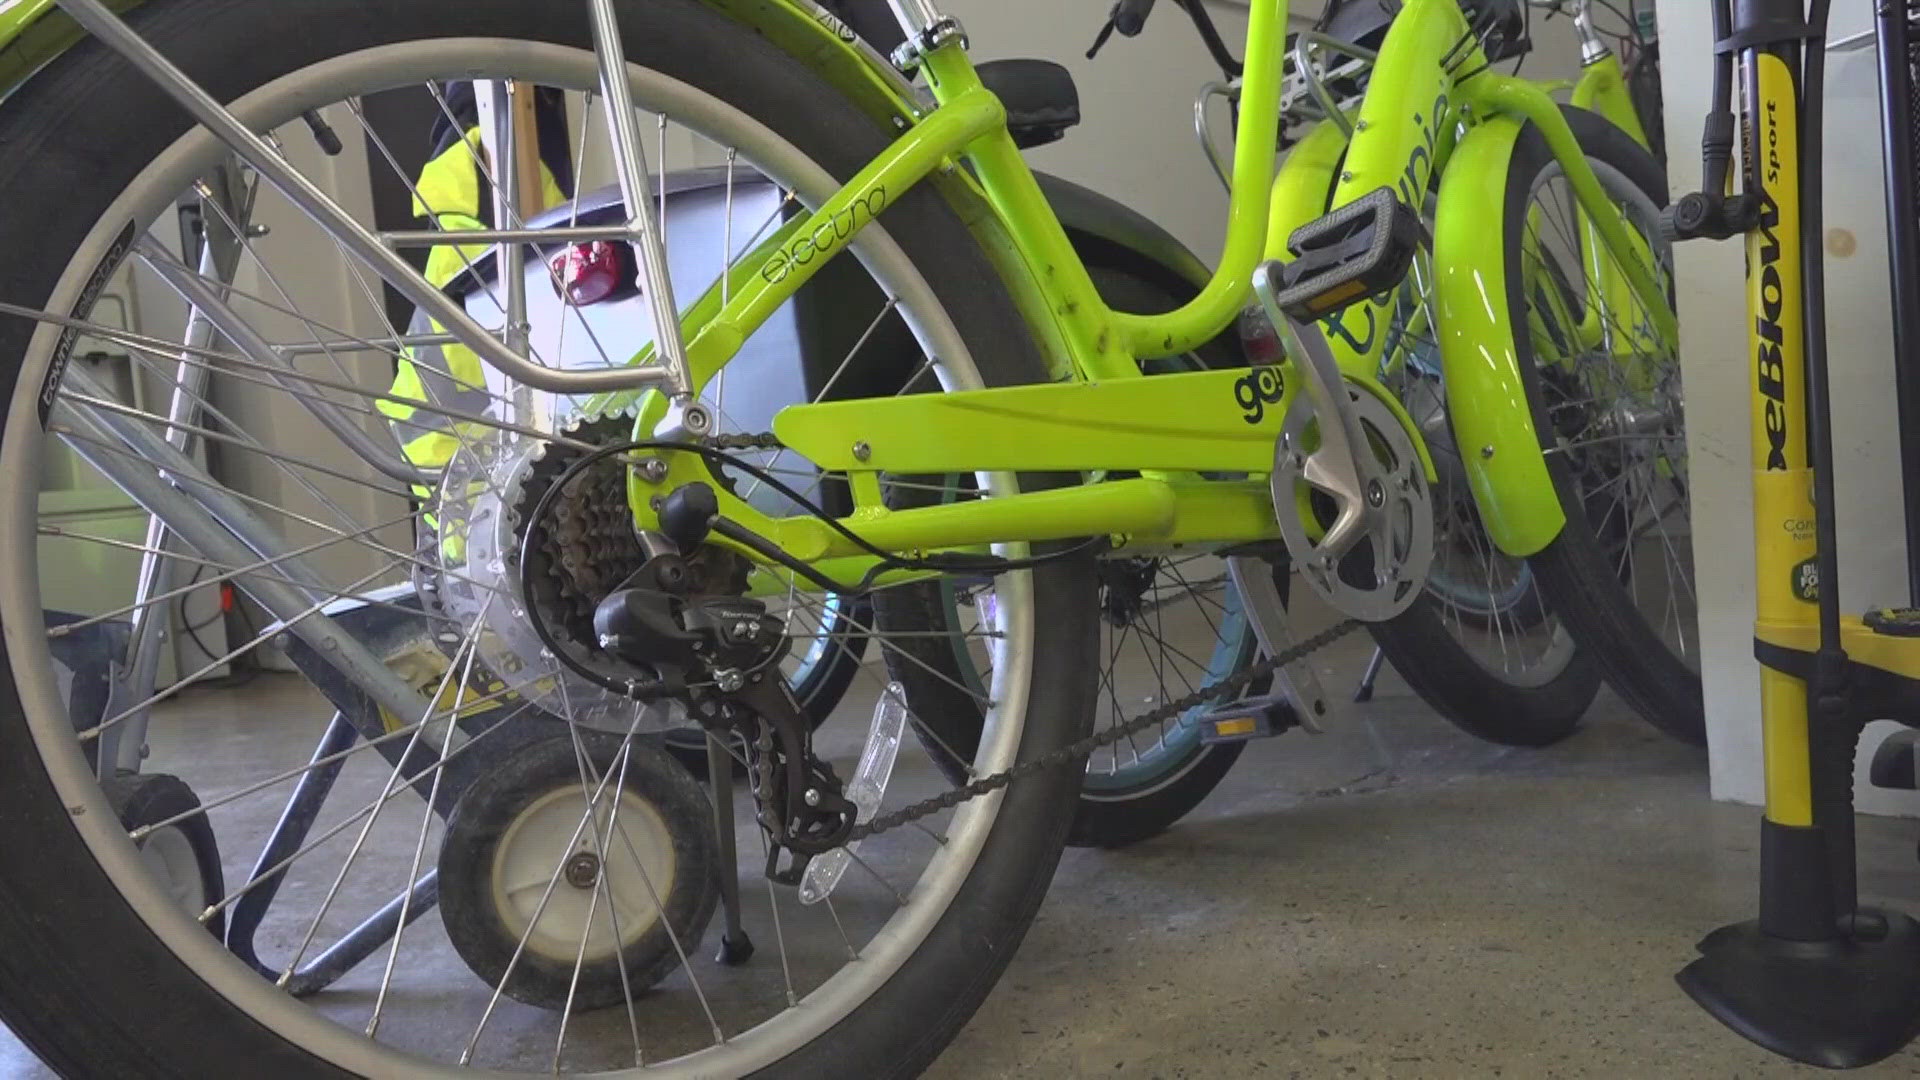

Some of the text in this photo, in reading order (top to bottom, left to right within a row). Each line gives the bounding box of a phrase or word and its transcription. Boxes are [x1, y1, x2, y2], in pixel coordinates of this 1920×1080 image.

[1766, 99, 1780, 185] Sport
[762, 184, 886, 284] electra
[1319, 93, 1449, 354] tnie
